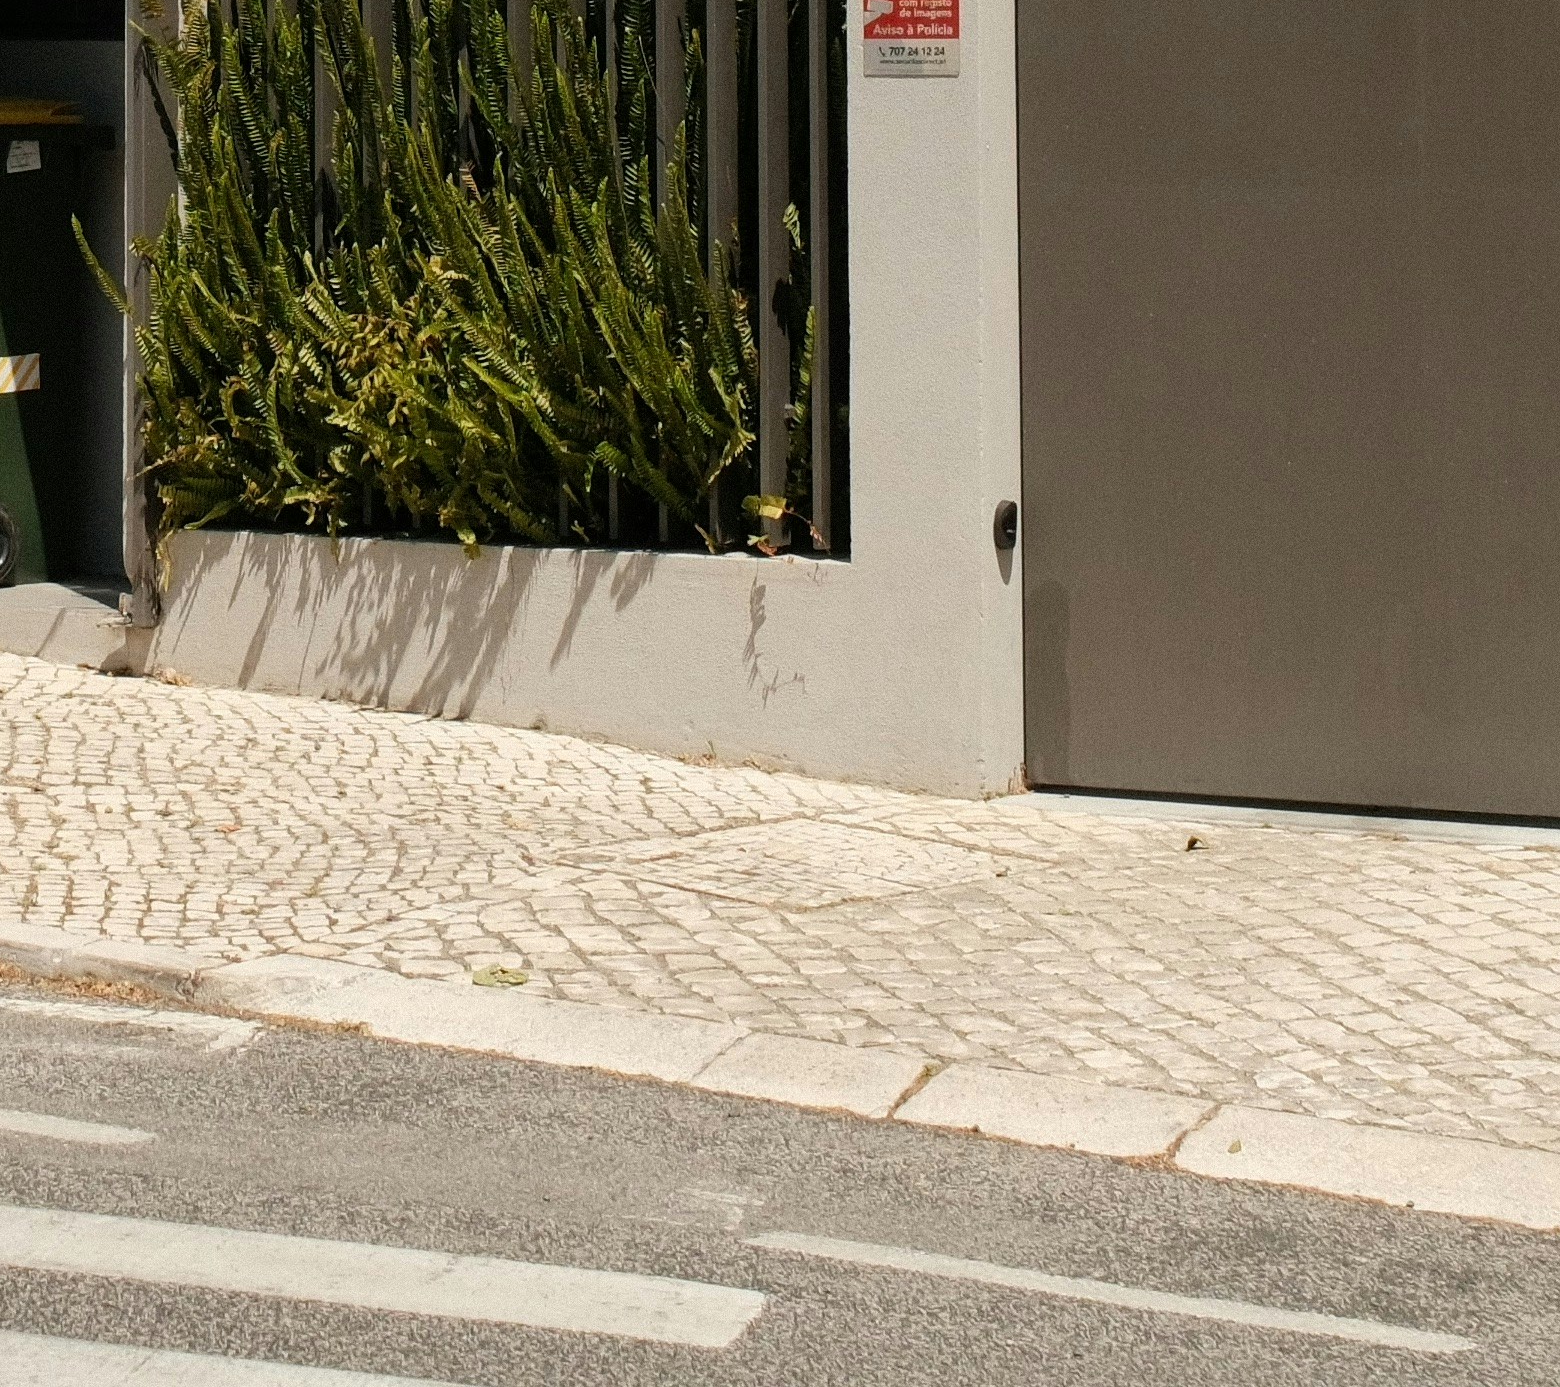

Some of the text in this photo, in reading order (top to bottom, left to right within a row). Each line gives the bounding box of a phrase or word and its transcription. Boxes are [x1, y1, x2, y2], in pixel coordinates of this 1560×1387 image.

[899, 0, 918, 7] com
[900, 7, 912, 17] de
[873, 24, 904, 35] Aviso
[917, 23, 953, 35] Polícia
[888, 46, 945, 56] 707 24 12 24
